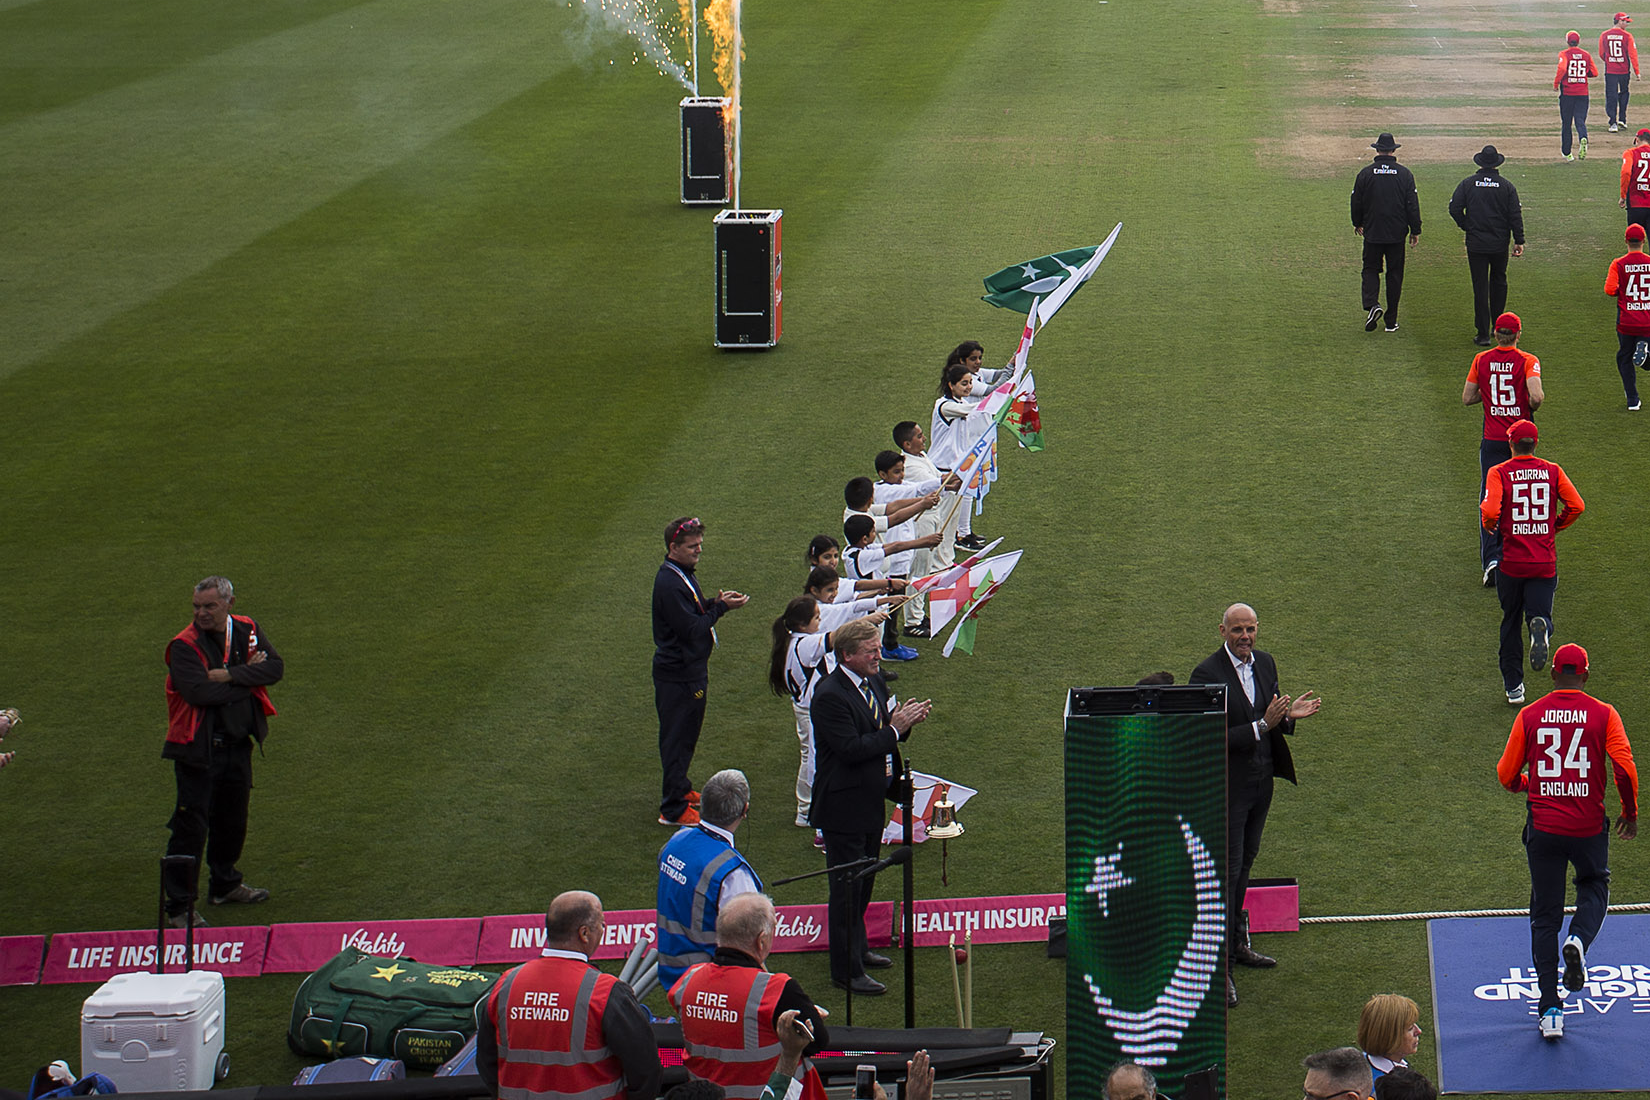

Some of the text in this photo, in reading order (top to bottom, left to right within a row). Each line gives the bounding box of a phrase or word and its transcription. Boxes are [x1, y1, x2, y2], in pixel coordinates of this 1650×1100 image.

[1608, 40, 1623, 57] 16
[1567, 60, 1587, 77] 66
[1489, 362, 1514, 373] WILLEY
[1489, 374, 1516, 406] 15
[1490, 406, 1521, 417] ENGLAND
[1508, 469, 1550, 481] T.CURRAN
[1511, 482, 1550, 522] 59
[1512, 523, 1549, 536] ENGLAND
[1540, 709, 1587, 724] JORDAN
[1536, 728, 1591, 778] 34
[1540, 781, 1589, 797] ENGLAND
[667, 853, 687, 872] CHIEF
[660, 861, 688, 886] STEWARD
[340, 928, 405, 958] Vitality
[510, 922, 656, 949] INVENTS
[67, 942, 244, 969] LIFE INSURANCE
[523, 991, 559, 1007] FIRE
[695, 990, 729, 1008] FIRE
[510, 1006, 570, 1023] STEWARD
[685, 1004, 739, 1024] STEWARD
[408, 1036, 452, 1048] PAKISTAN
